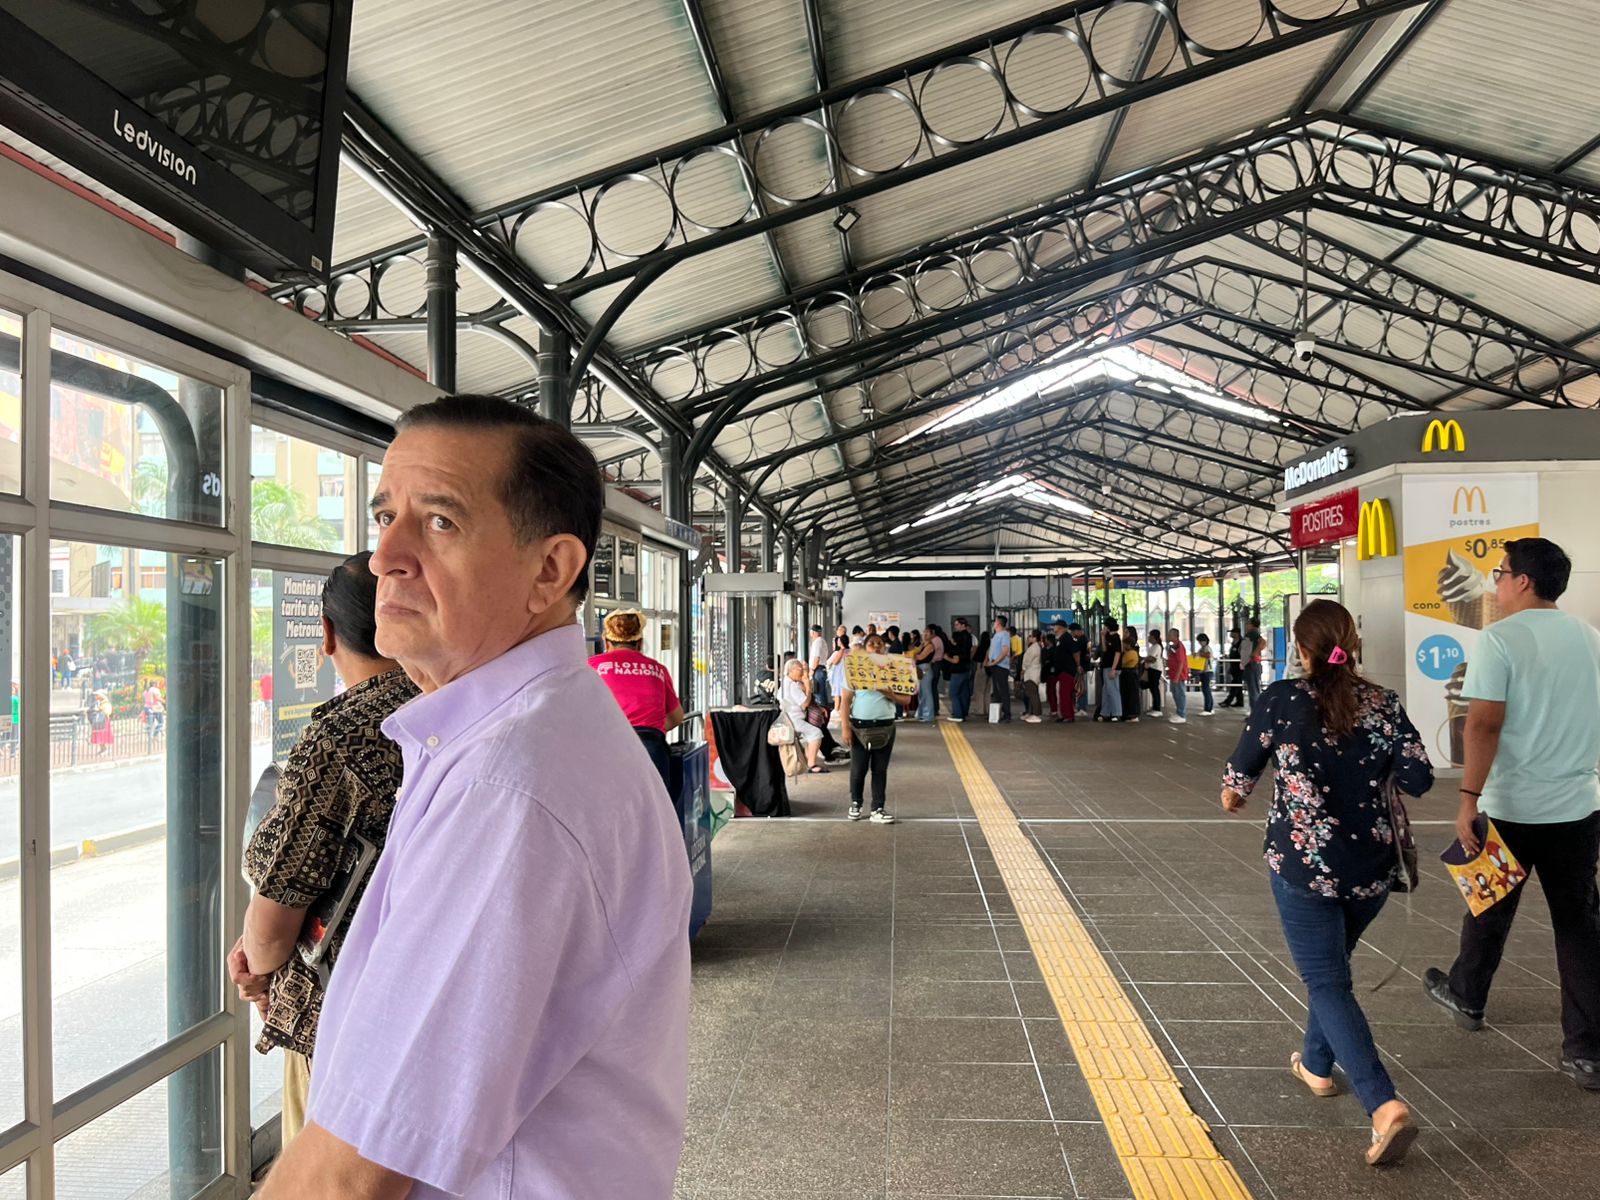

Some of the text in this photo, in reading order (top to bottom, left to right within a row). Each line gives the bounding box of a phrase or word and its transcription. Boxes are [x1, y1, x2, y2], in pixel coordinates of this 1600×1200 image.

[113, 108, 196, 185] Ledvision
[1284, 446, 1349, 491] McDonald's
[1302, 504, 1344, 534] POSTRES
[1449, 518, 1491, 529] postres
[284, 577, 317, 596] Mantén
[281, 599, 307, 617] tarifa
[308, 600, 319, 617] de
[1412, 602, 1441, 610] cono
[286, 620, 324, 638] Metrovía
